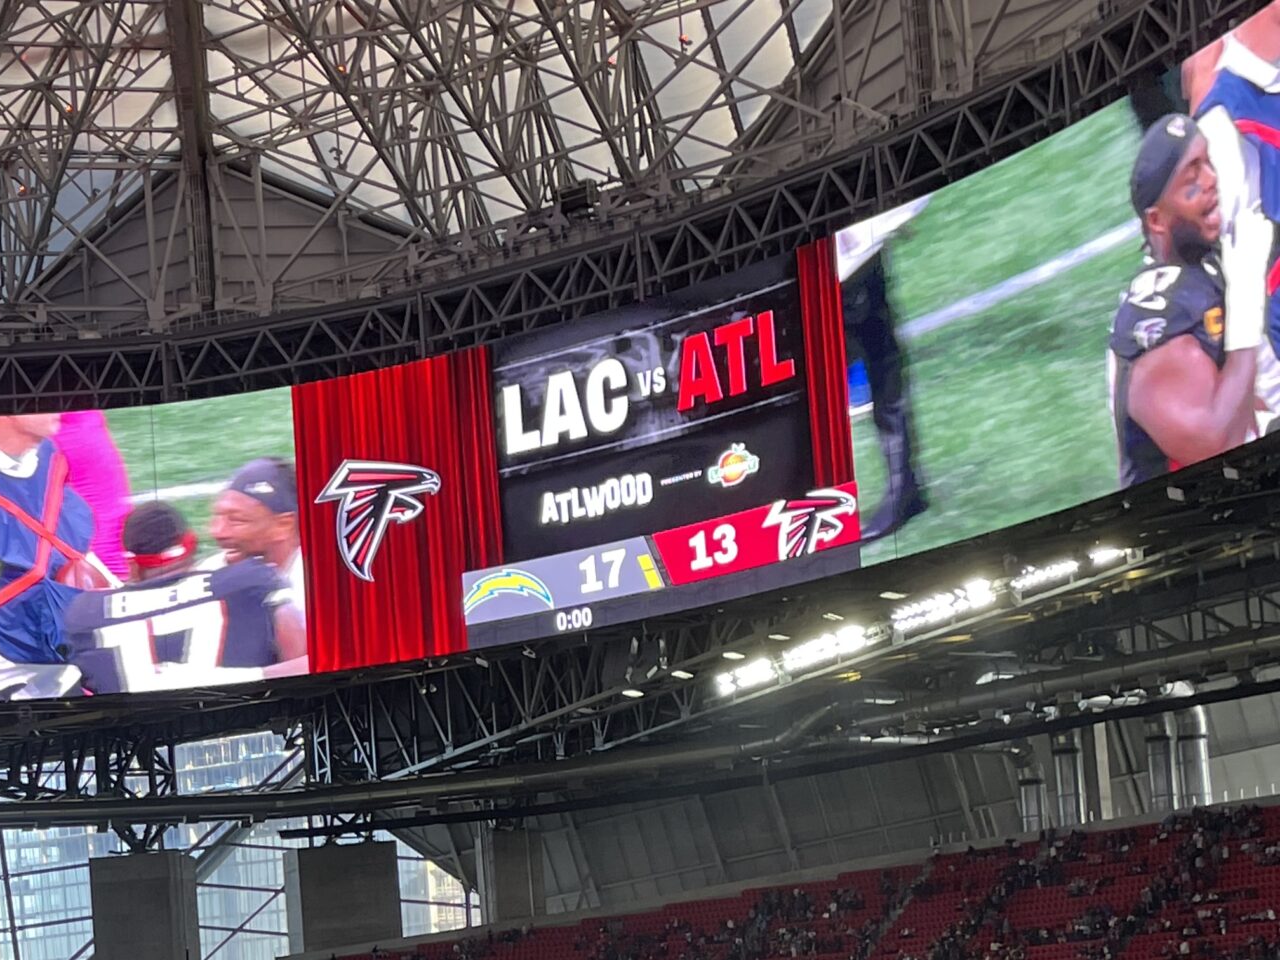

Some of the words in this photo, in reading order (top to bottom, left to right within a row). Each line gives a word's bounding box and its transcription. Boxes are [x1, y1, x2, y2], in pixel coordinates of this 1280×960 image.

[501, 358, 629, 455] LAC
[637, 367, 666, 397] VS
[677, 310, 796, 412] ATL
[541, 472, 654, 524] ATLWOOD
[578, 549, 626, 593] 17
[688, 524, 738, 571] 13
[556, 608, 593, 631] 0:00
